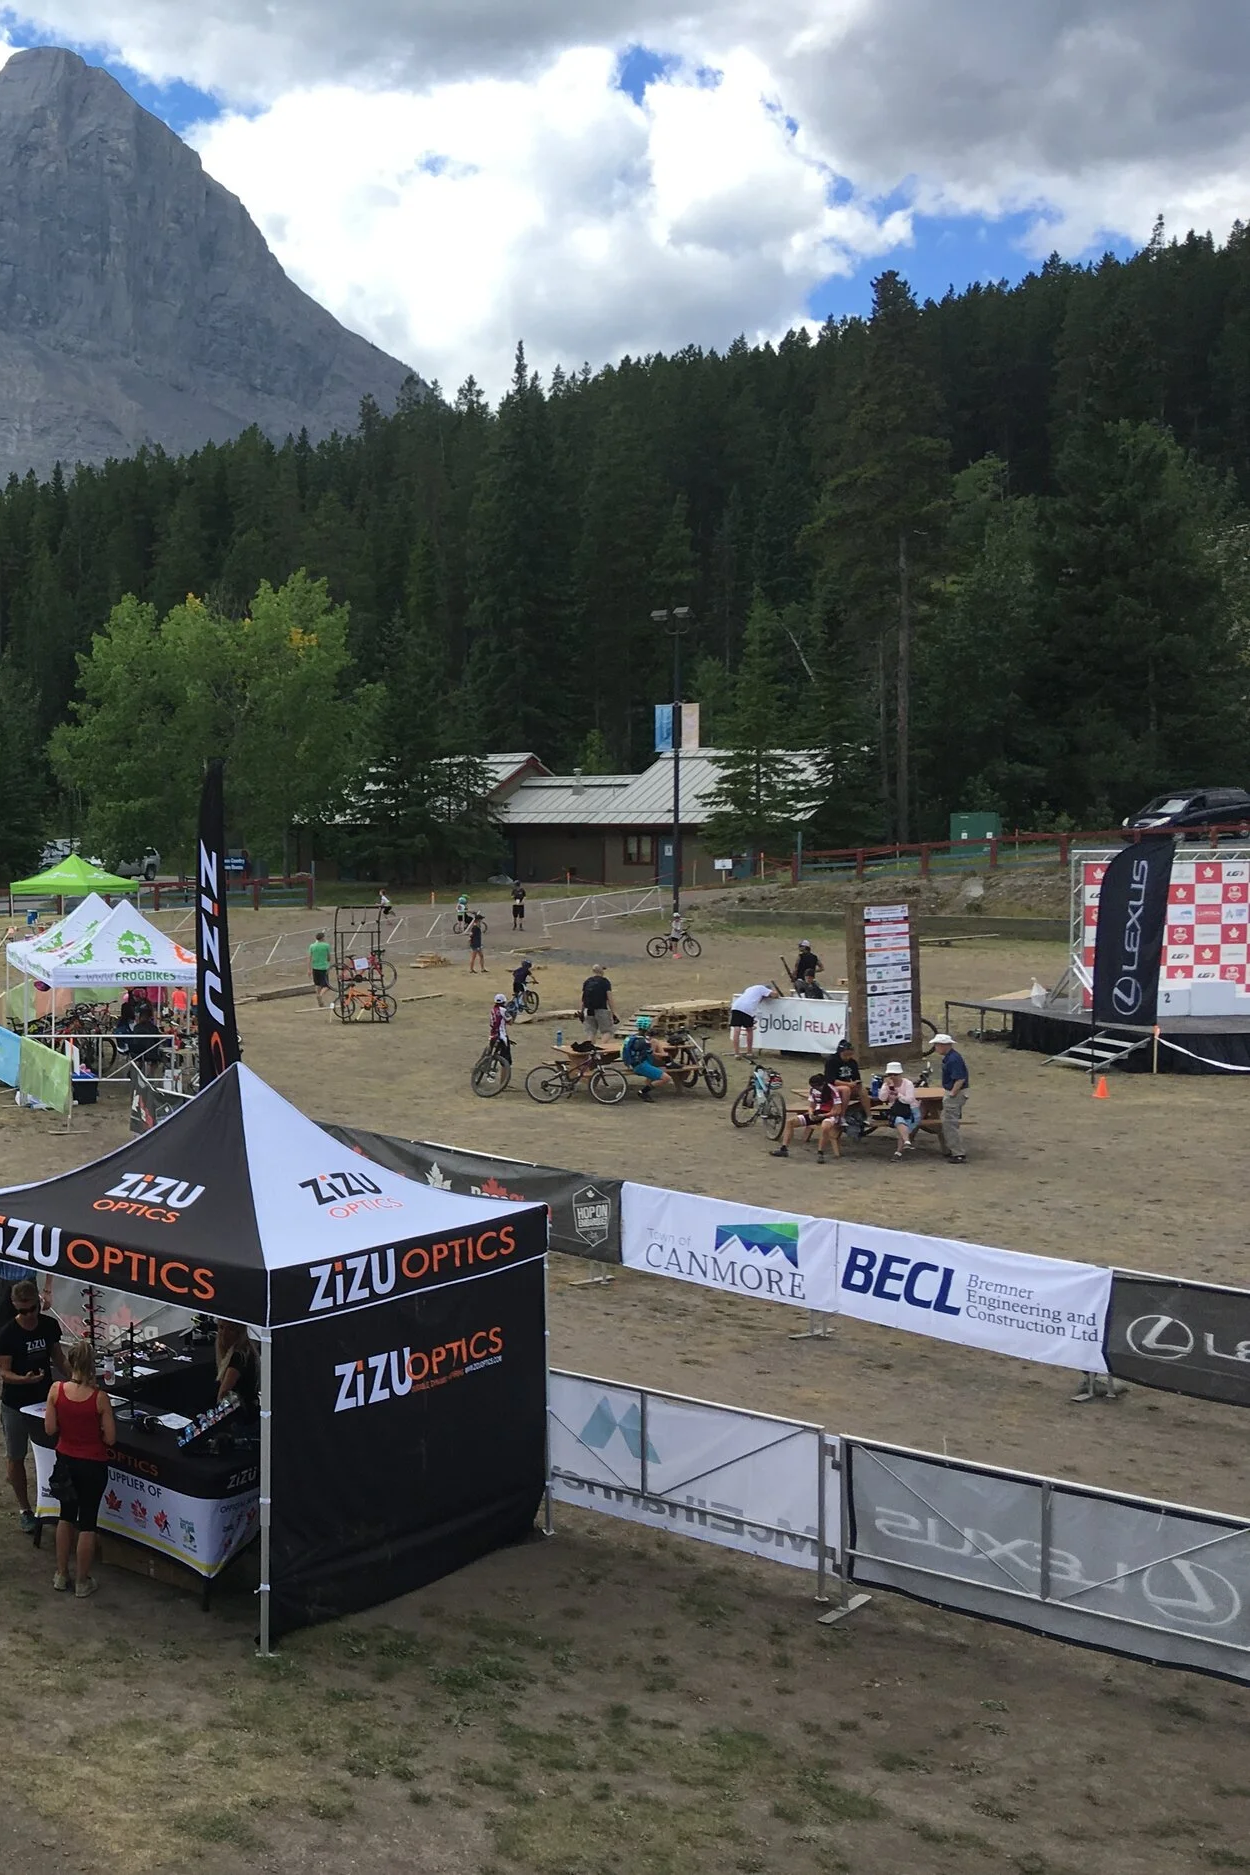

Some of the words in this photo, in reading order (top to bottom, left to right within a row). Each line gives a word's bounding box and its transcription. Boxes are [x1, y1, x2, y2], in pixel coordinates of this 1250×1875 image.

[1121, 859, 1148, 971] LEXUS
[1164, 992, 1171, 1004] 2
[759, 1013, 802, 1033] global
[92, 1199, 181, 1224] OPTICS
[329, 1197, 404, 1219] OPTICS
[576, 1205, 595, 1220] HOP
[595, 1204, 608, 1218] ON
[647, 1227, 675, 1244] Town
[678, 1236, 692, 1247] of
[401, 1226, 516, 1279] OPTICS
[66, 1238, 215, 1300] OPTICS
[645, 1242, 806, 1300] CANMORE
[840, 1246, 962, 1316] BECL
[966, 1273, 1034, 1300] Bremner
[965, 1289, 1062, 1322] Engineering
[1066, 1310, 1097, 1327] and
[965, 1305, 1067, 1337] Construction
[1070, 1325, 1103, 1343] Ltd.
[406, 1326, 503, 1381] OPTICS
[106, 1448, 159, 1477] OPTICS
[108, 1469, 146, 1493] UPPLIER
[148, 1485, 163, 1499] OF
